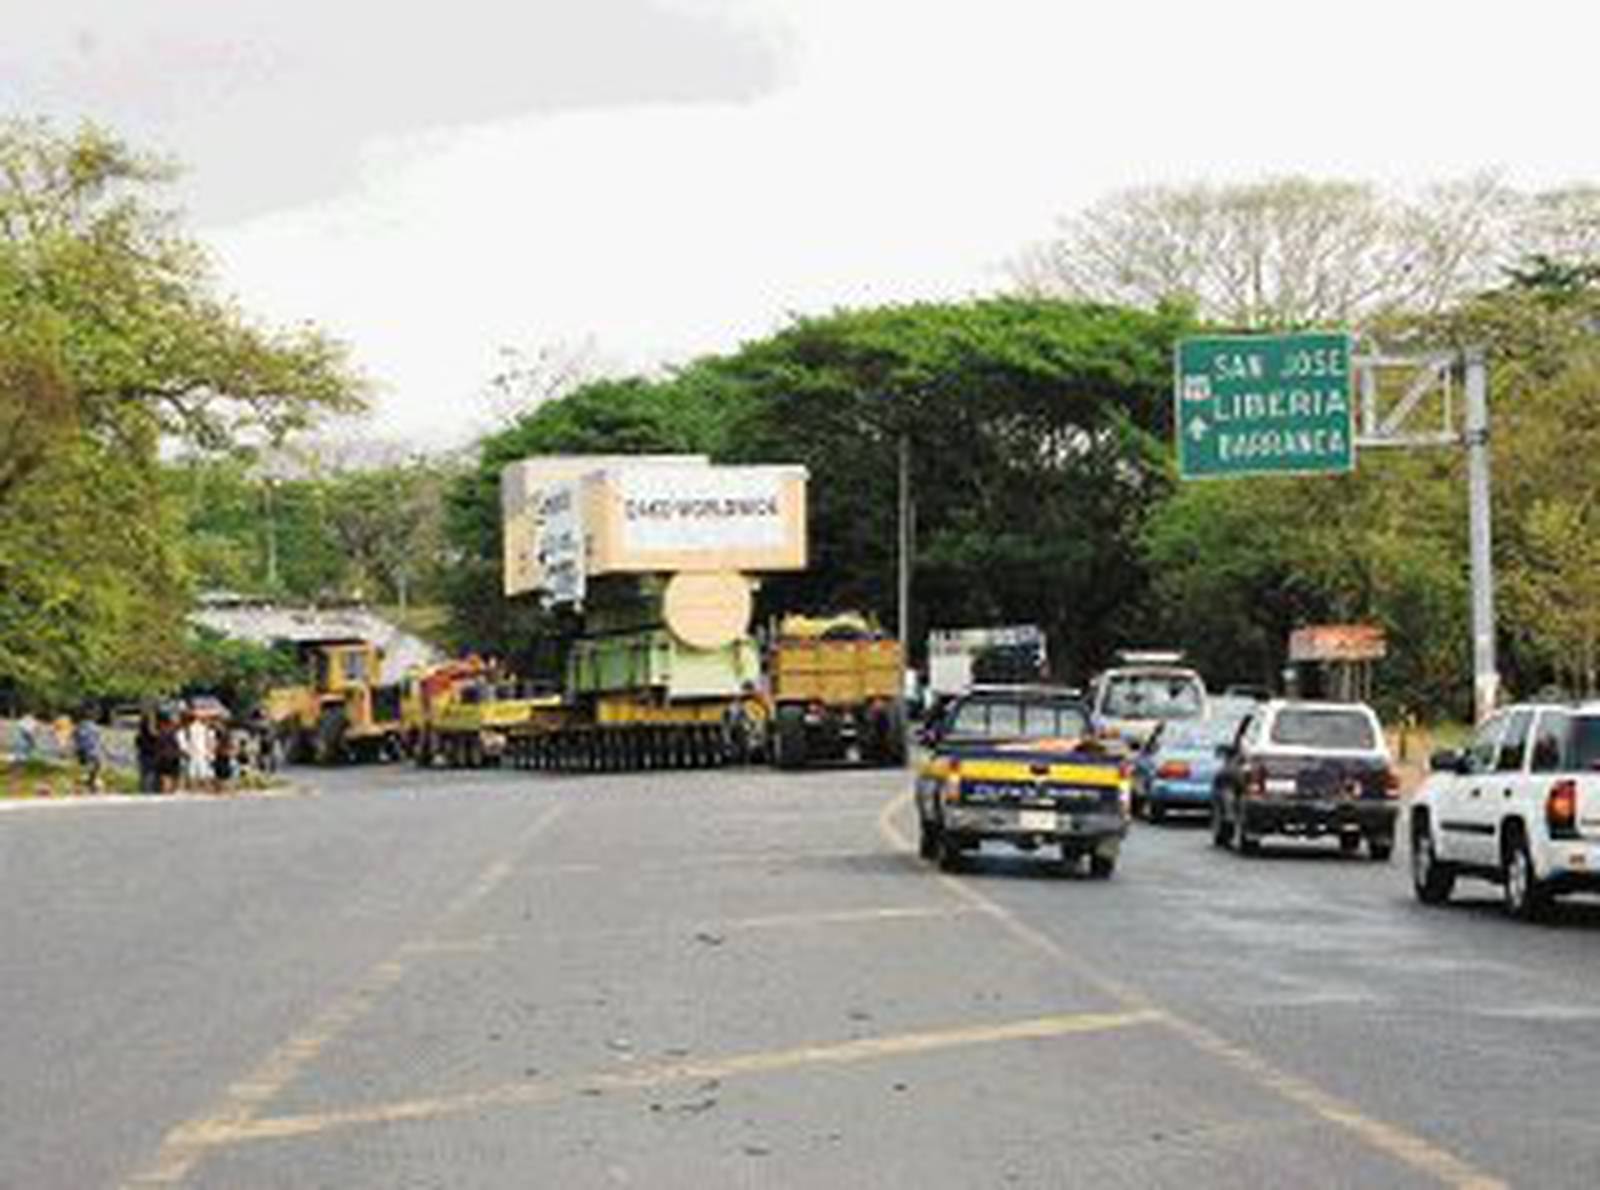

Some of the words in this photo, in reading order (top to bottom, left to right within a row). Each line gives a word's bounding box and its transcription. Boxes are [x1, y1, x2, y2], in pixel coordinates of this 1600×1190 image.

[1214, 353, 1264, 381] SAN
[1280, 349, 1345, 377] JOSE
[1214, 390, 1346, 420] LIBERIA
